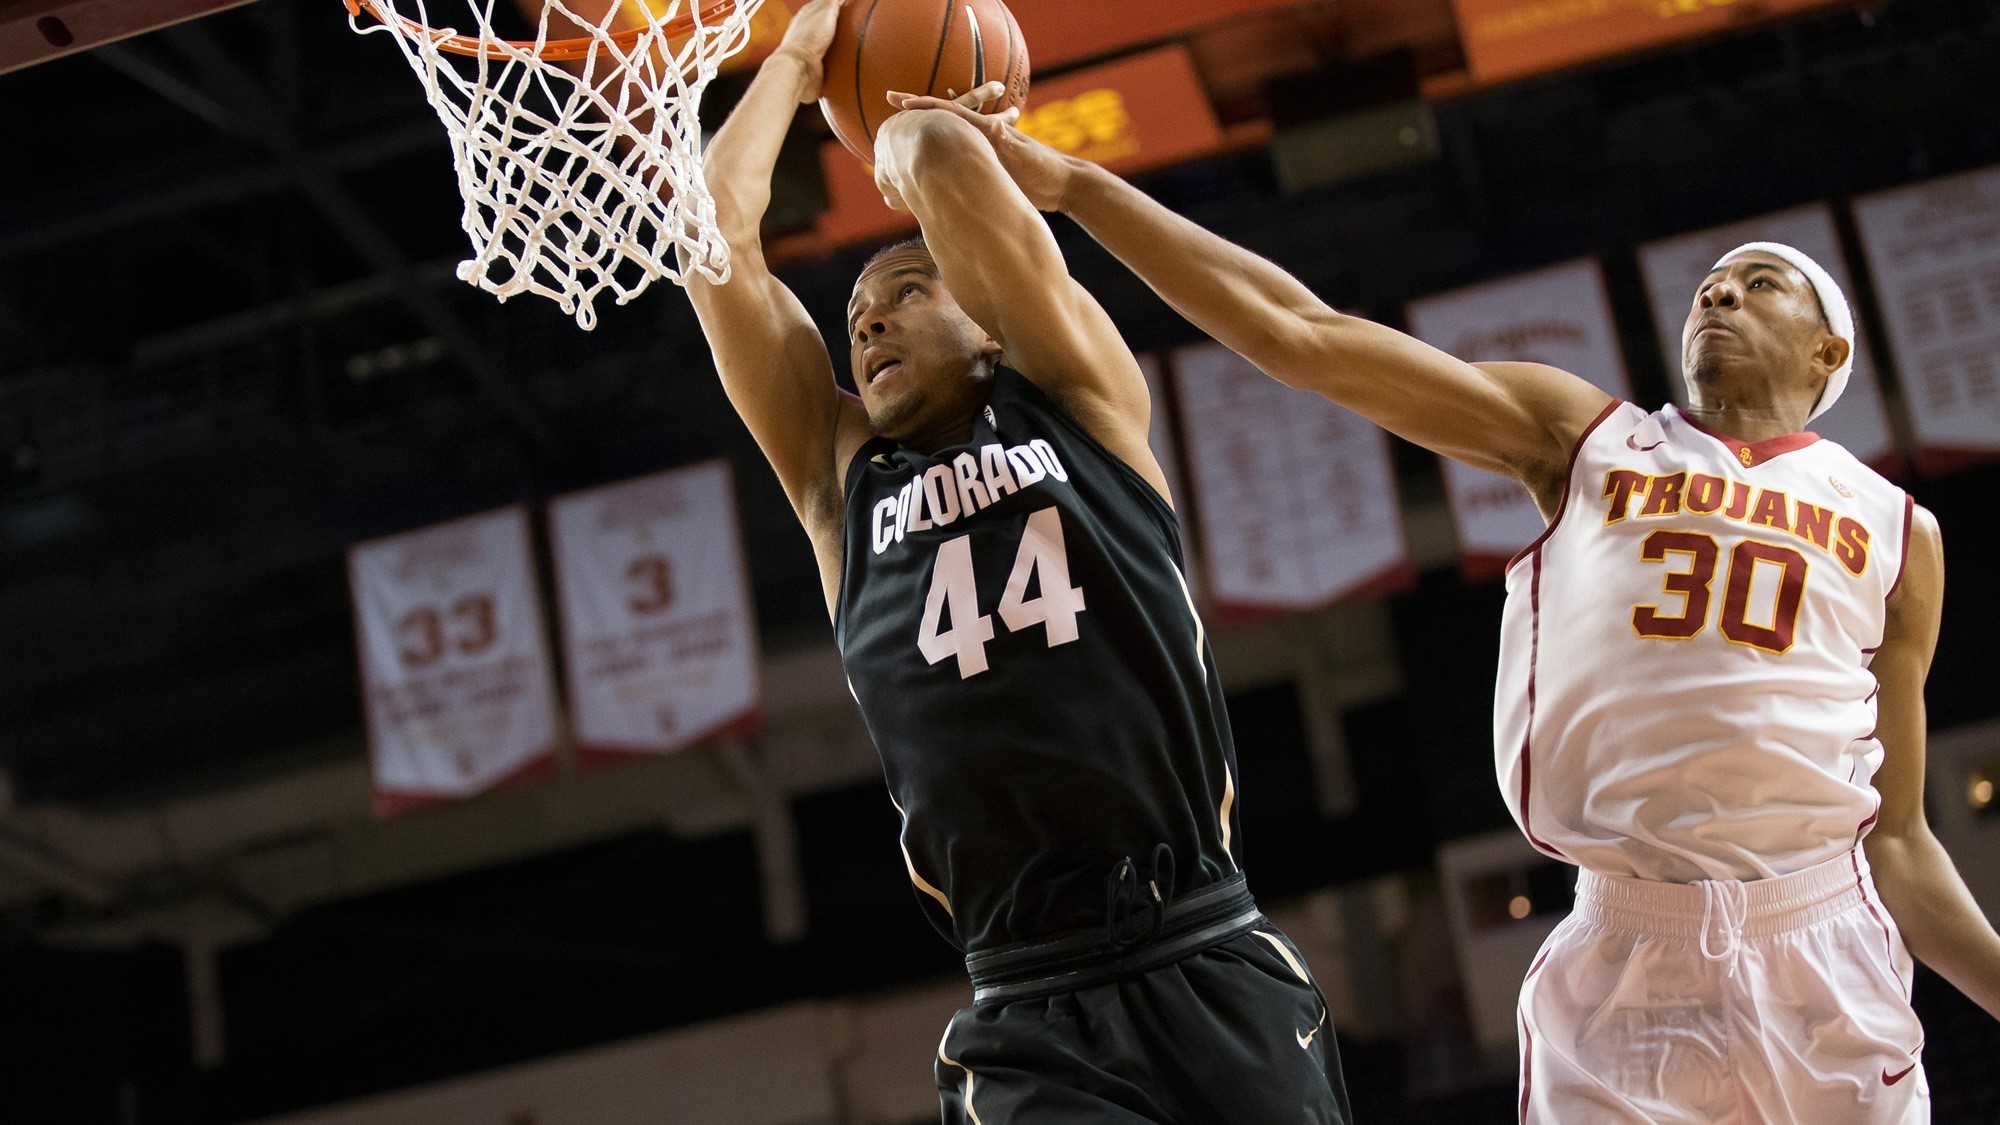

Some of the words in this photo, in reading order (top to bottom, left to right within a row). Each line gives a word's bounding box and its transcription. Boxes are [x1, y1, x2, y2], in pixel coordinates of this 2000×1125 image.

[872, 438, 1068, 555] COLORADO
[1603, 469, 1870, 577] TROJANS
[398, 594, 498, 669] 33
[623, 552, 677, 618] 3
[917, 505, 1086, 679] 44
[1631, 529, 1808, 655] 30
